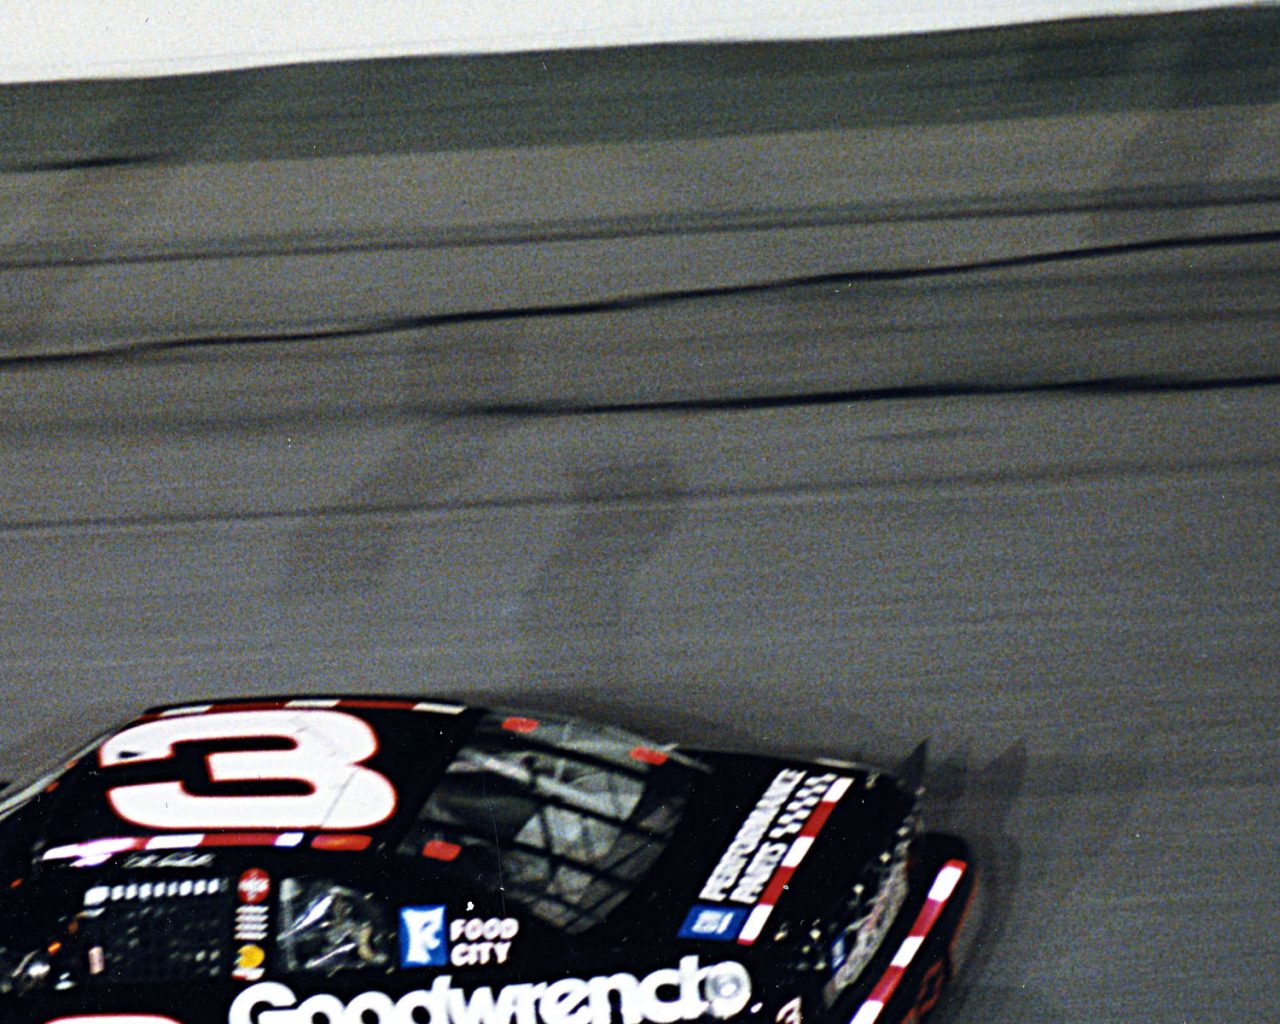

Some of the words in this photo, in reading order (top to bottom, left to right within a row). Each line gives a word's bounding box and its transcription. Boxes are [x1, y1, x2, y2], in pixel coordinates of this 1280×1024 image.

[100, 708, 397, 830] 3
[449, 918, 519, 941] FOOD
[451, 942, 512, 966] CITY
